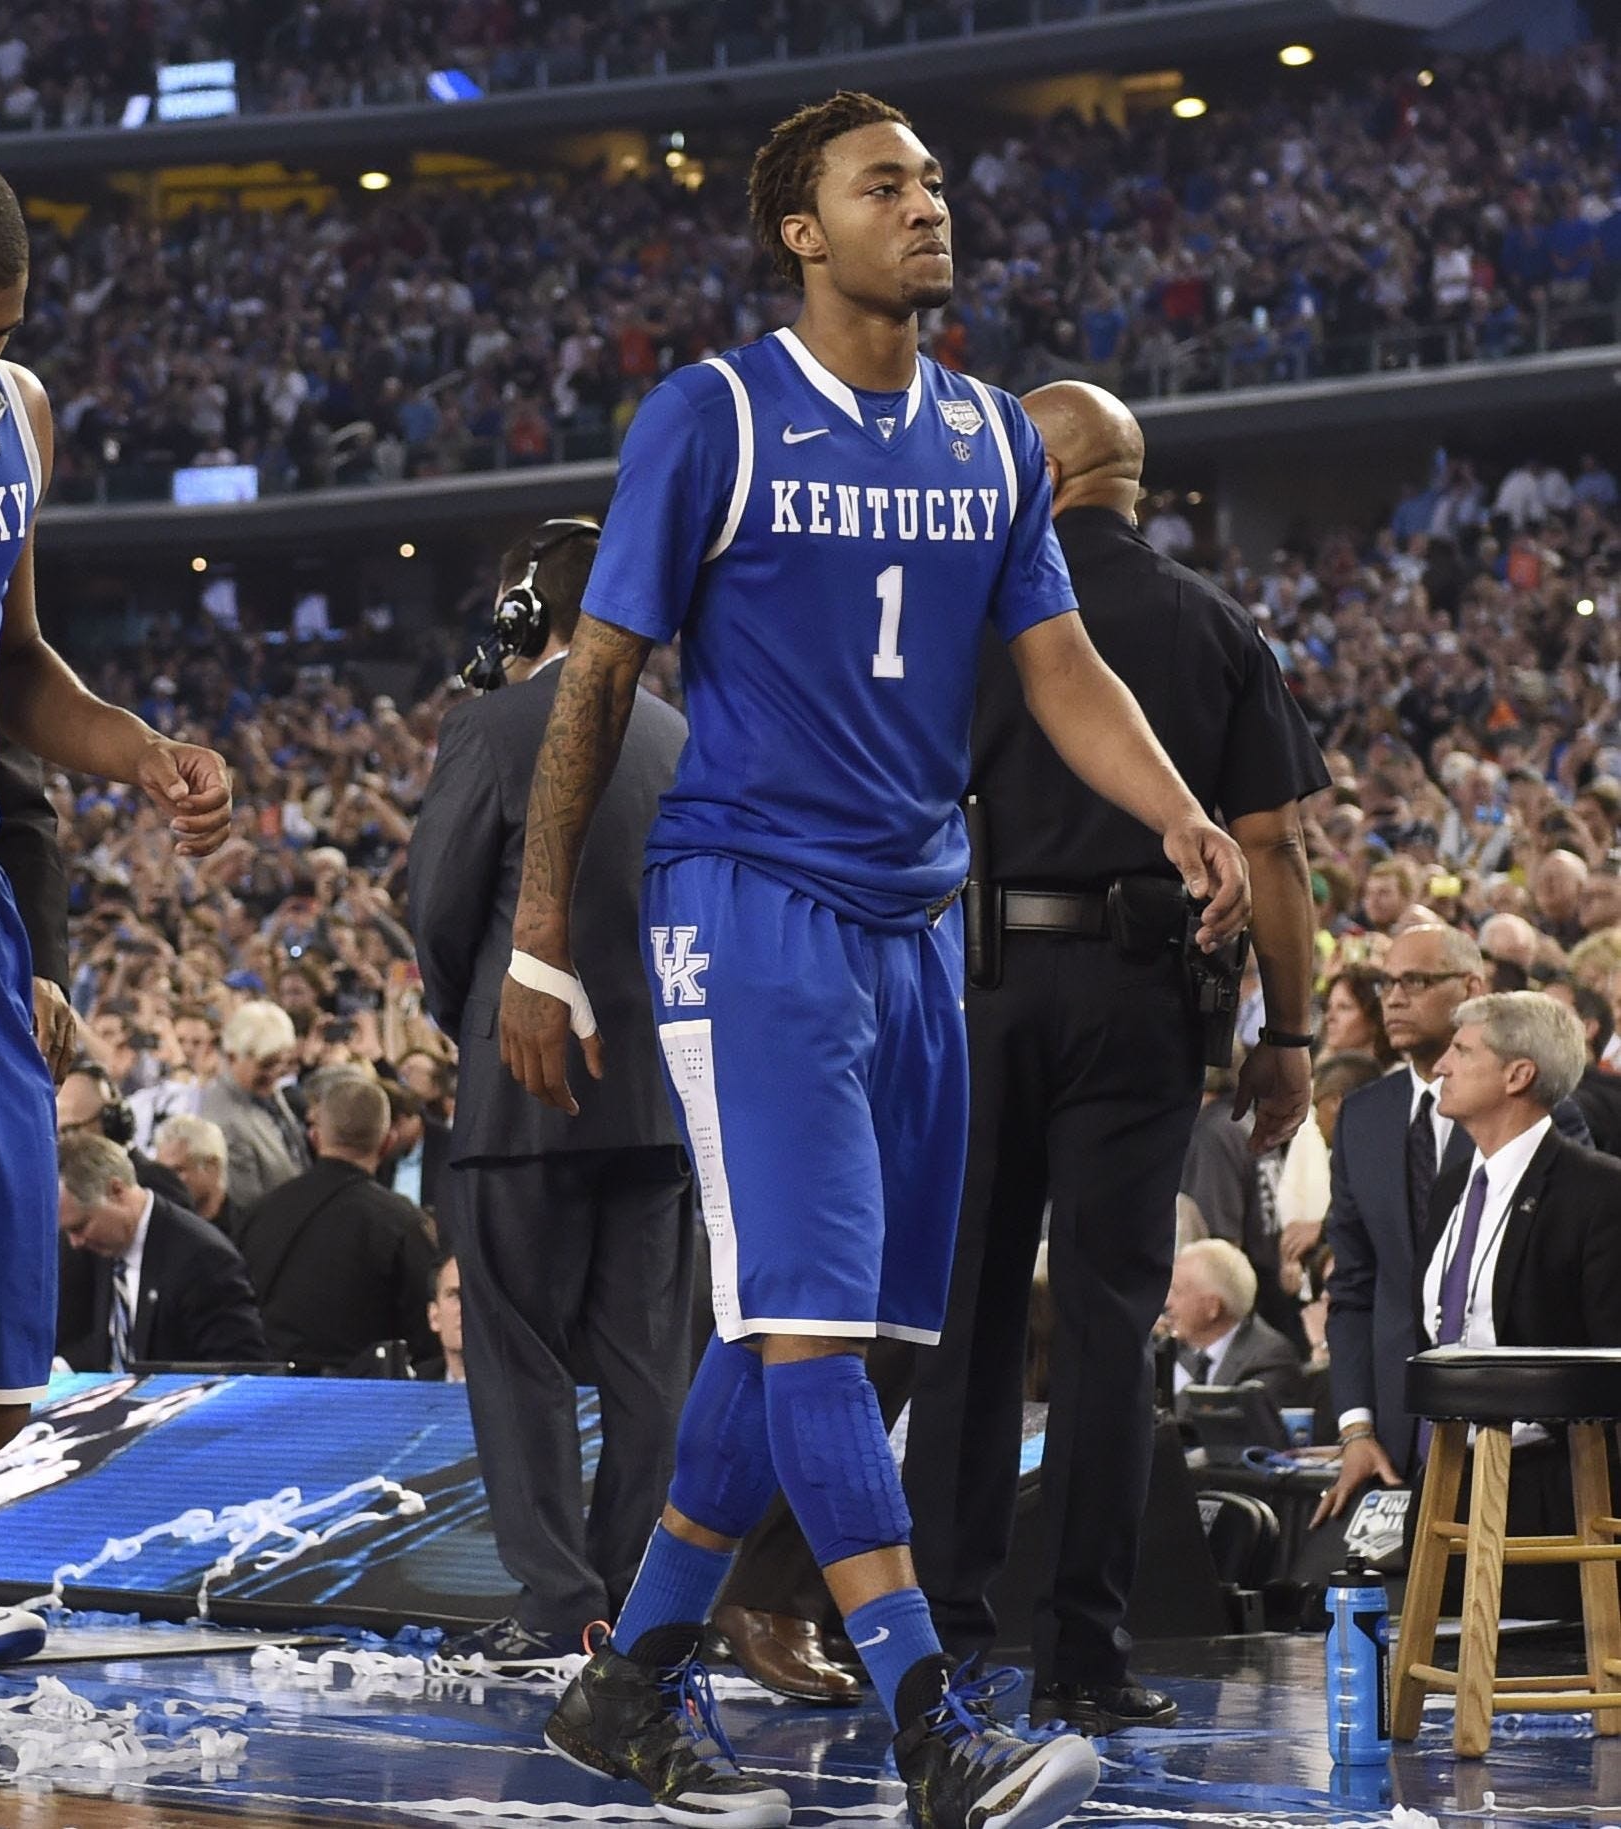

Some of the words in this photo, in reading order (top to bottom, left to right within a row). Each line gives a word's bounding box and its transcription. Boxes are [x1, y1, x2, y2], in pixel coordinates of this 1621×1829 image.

[771, 480, 998, 541] KENTUCKY
[872, 565, 904, 678] 1
[650, 925, 710, 1007] UK
